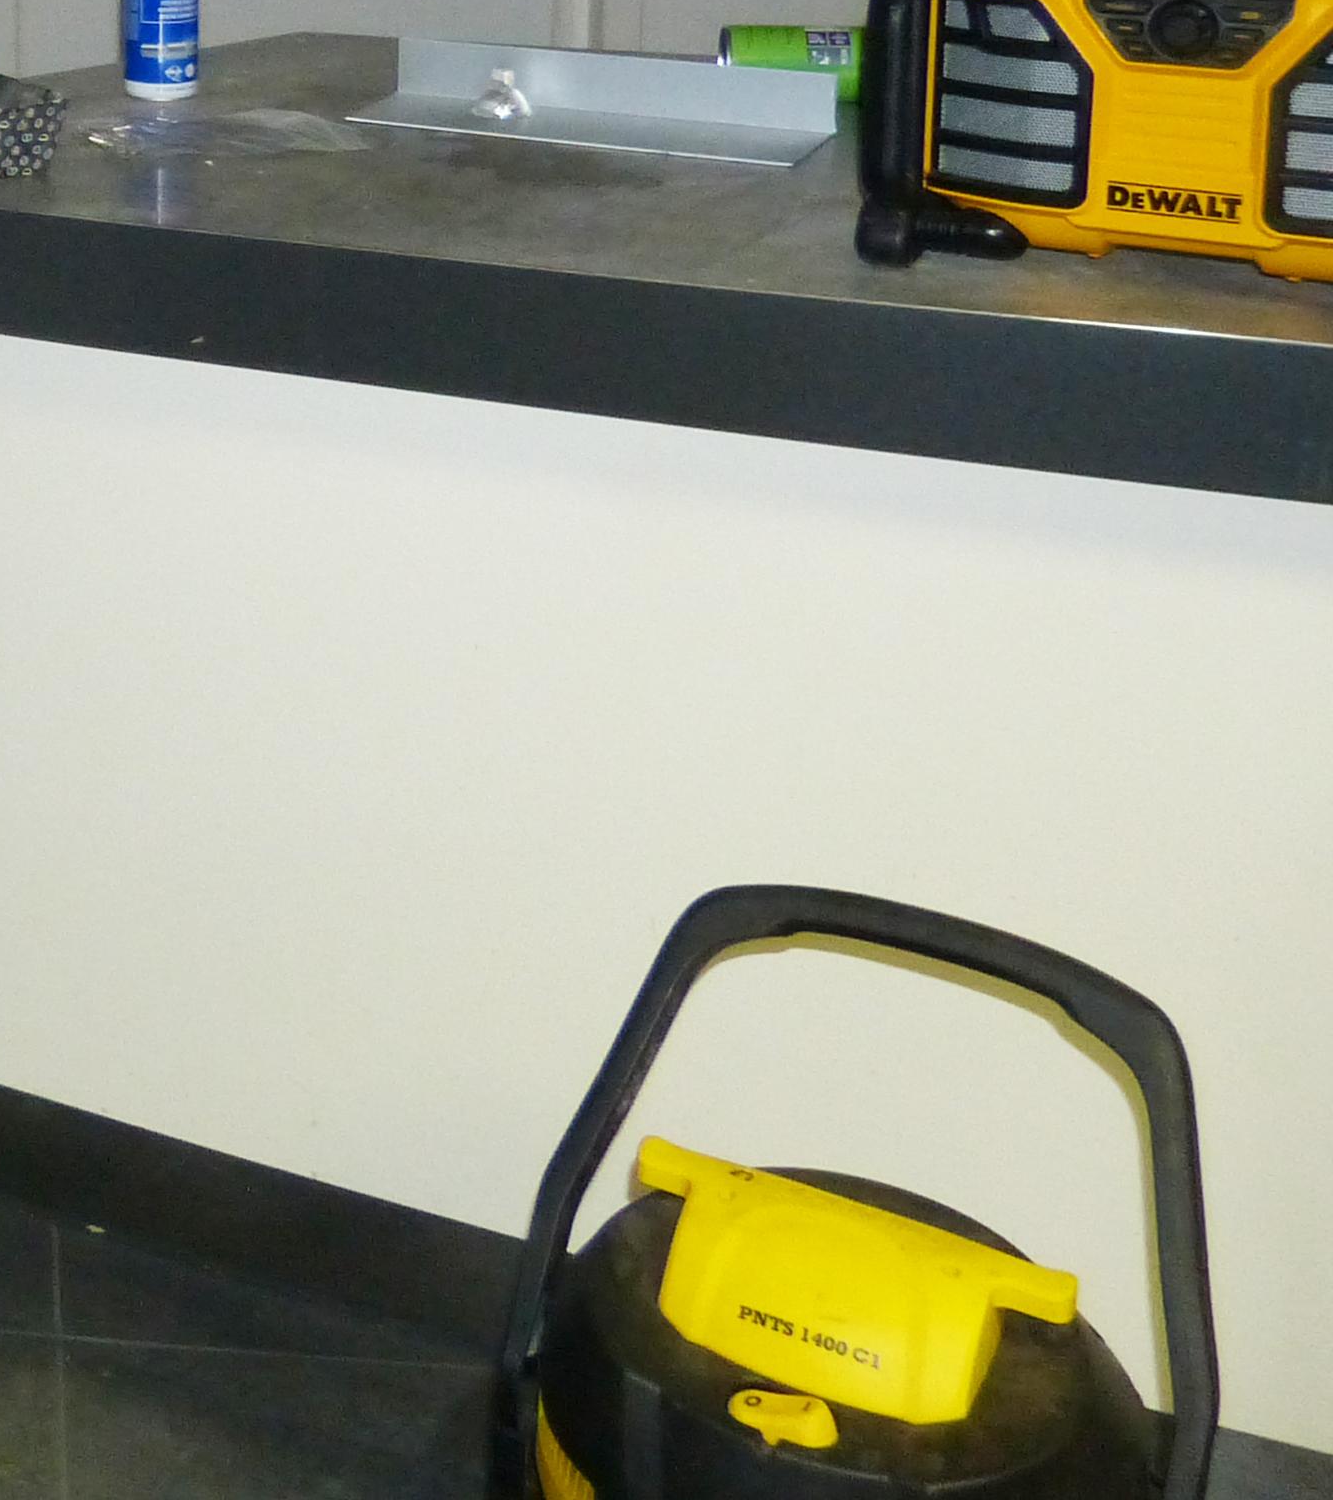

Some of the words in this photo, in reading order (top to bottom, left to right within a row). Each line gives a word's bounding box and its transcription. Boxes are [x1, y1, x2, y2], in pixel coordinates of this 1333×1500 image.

[738, 1305, 794, 1337] PNTS
[801, 1327, 848, 1356] 1400
[853, 1348, 881, 1370] C1
